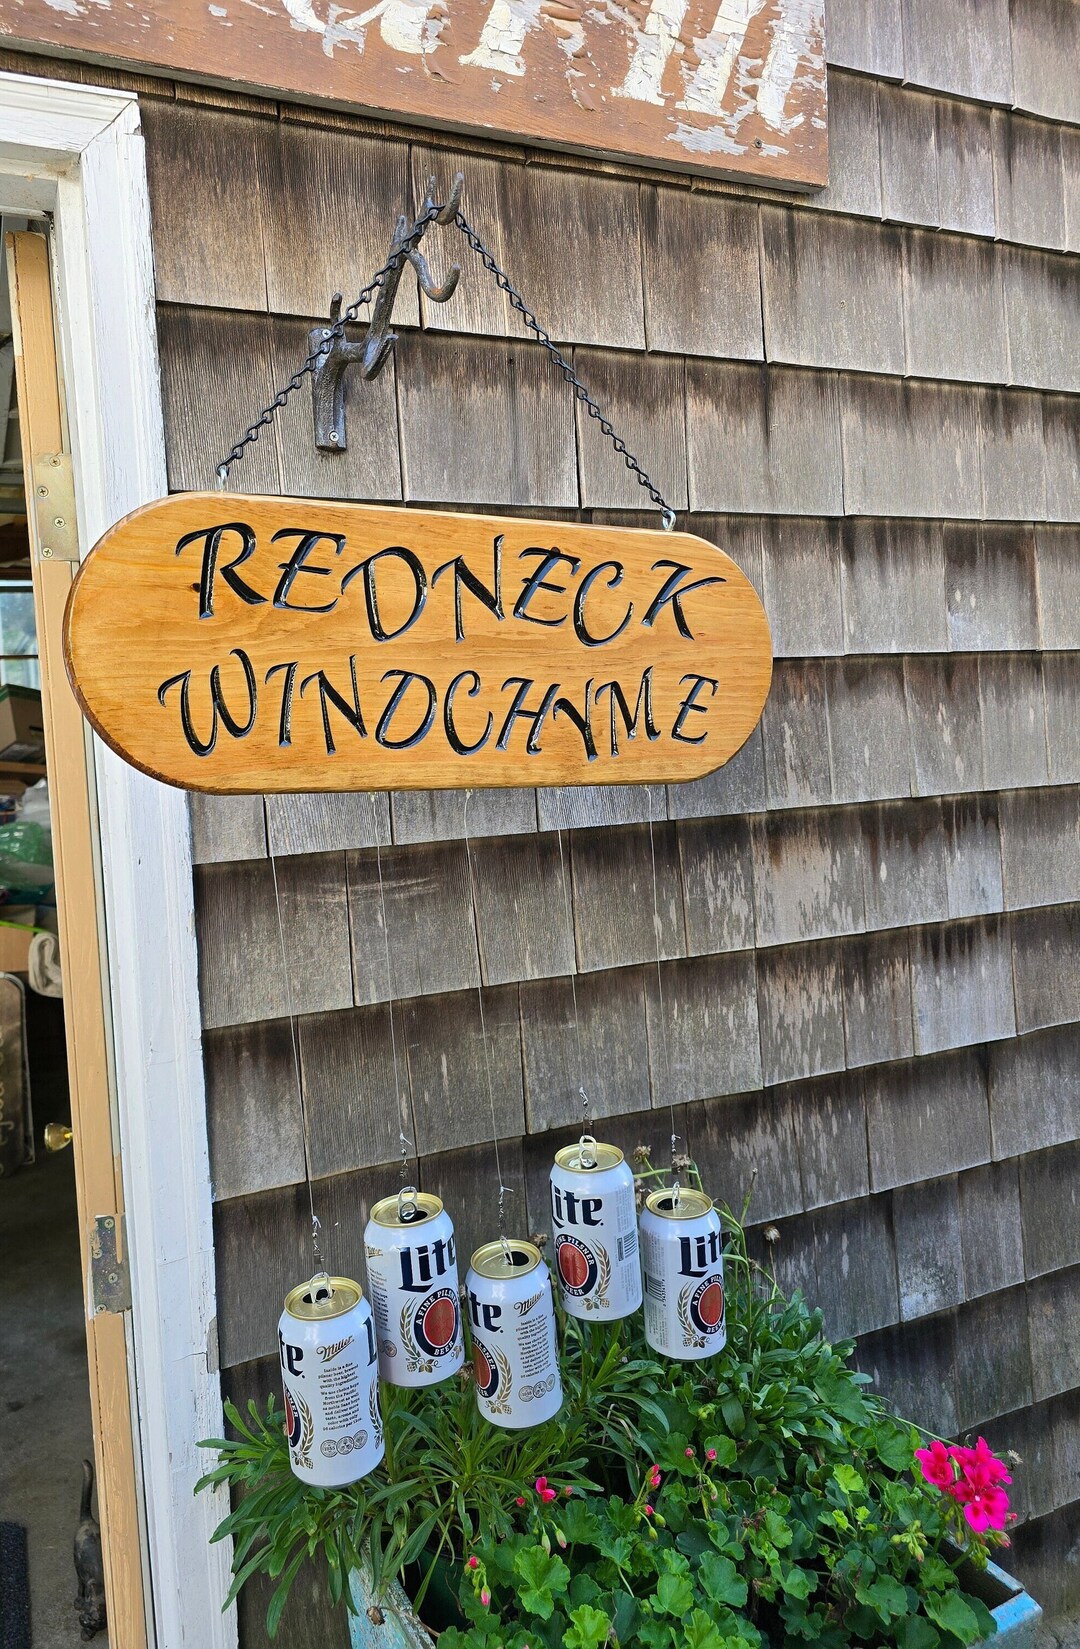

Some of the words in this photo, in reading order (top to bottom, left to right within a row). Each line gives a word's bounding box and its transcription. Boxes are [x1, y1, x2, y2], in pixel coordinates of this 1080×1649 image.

[175, 521, 727, 647] REDNECK
[158, 648, 719, 762] WINDCHYME
[418, 1295, 436, 1317] FINE
[316, 1335, 355, 1363] Miller
[433, 1341, 454, 1356] BEER
